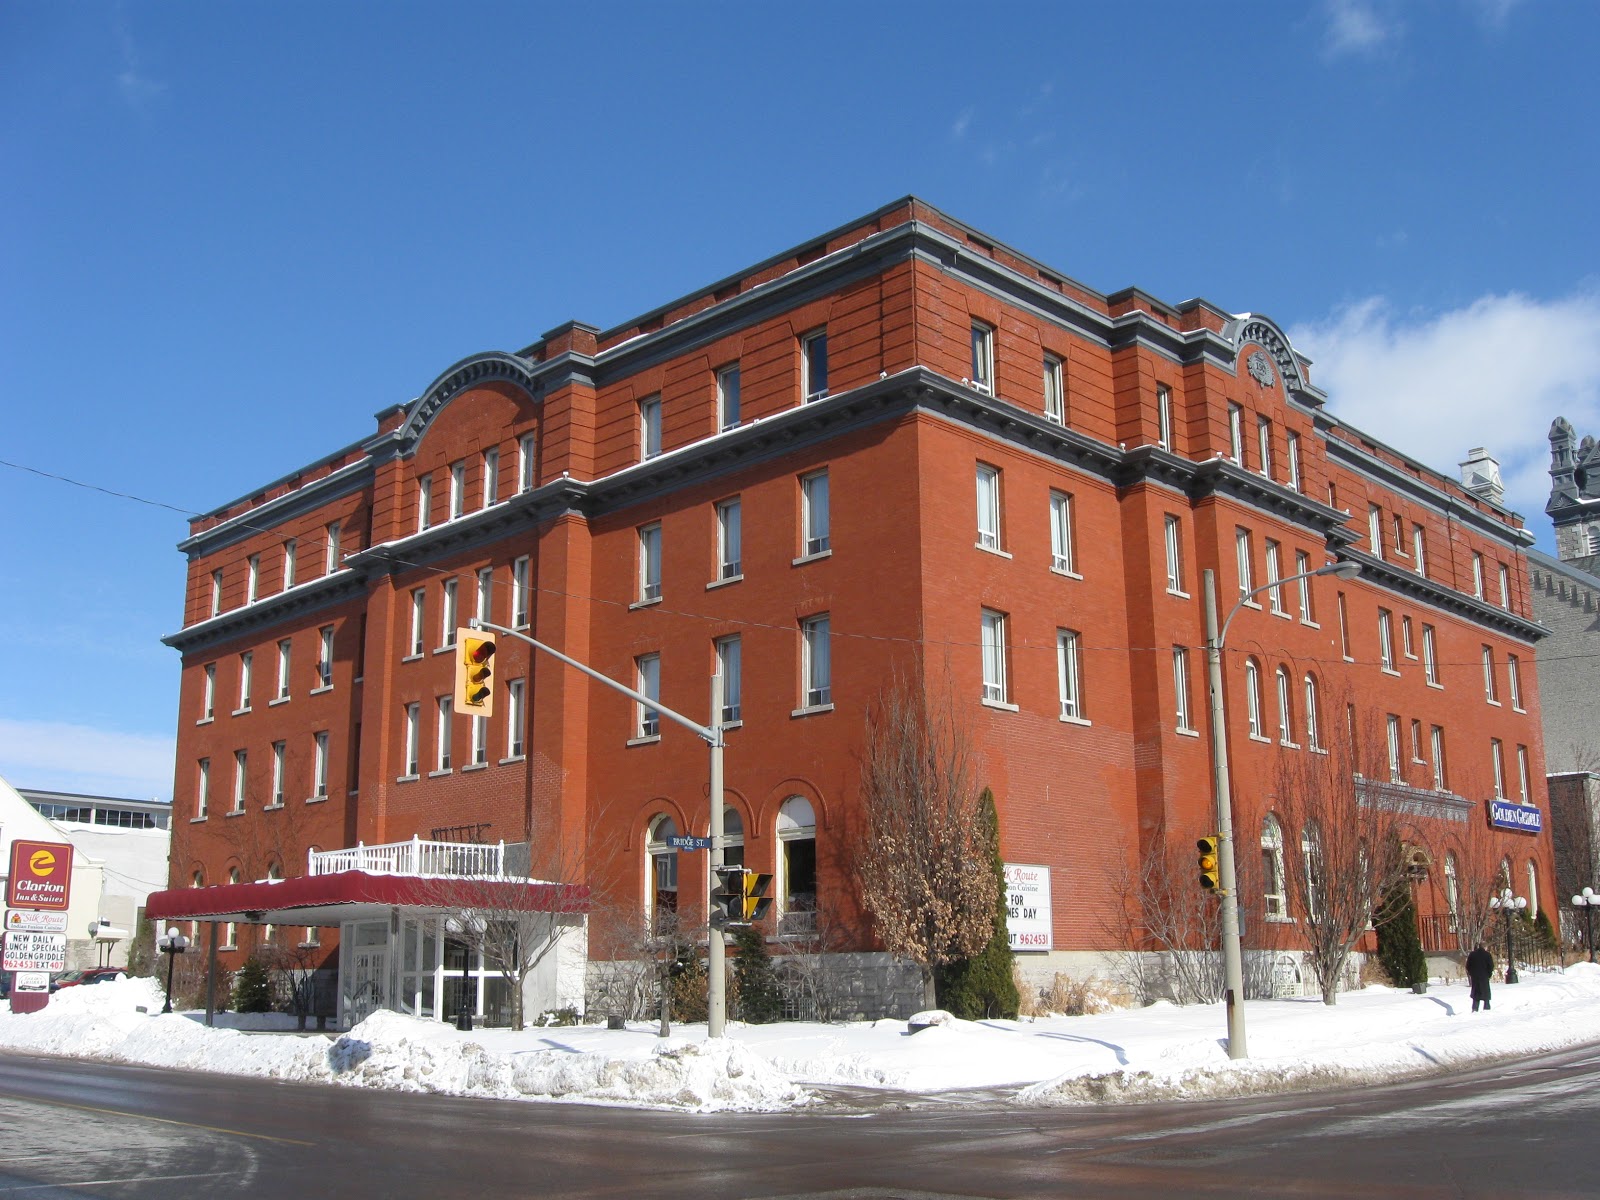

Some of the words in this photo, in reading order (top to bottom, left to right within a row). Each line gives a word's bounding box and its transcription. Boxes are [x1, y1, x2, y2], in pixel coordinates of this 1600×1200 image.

[1492, 803, 1517, 822] GOLDEN
[673, 838, 694, 846] BRIDGE
[696, 839, 705, 847] ST.
[1014, 868, 1038, 884] Route
[17, 880, 65, 893] Clarion
[1011, 894, 1024, 906] FOR
[23, 913, 41, 924] Silk
[40, 914, 65, 924] Route
[1023, 908, 1037, 919] DAY
[13, 934, 30, 942] NEW
[33, 935, 54, 944] DAILY
[1020, 934, 1048, 945] 9624531
[5, 943, 28, 951] LUNCH
[32, 944, 66, 952] SPECIALS
[5, 951, 33, 960] GOLDEN
[34, 953, 64, 961] GRIDDLE
